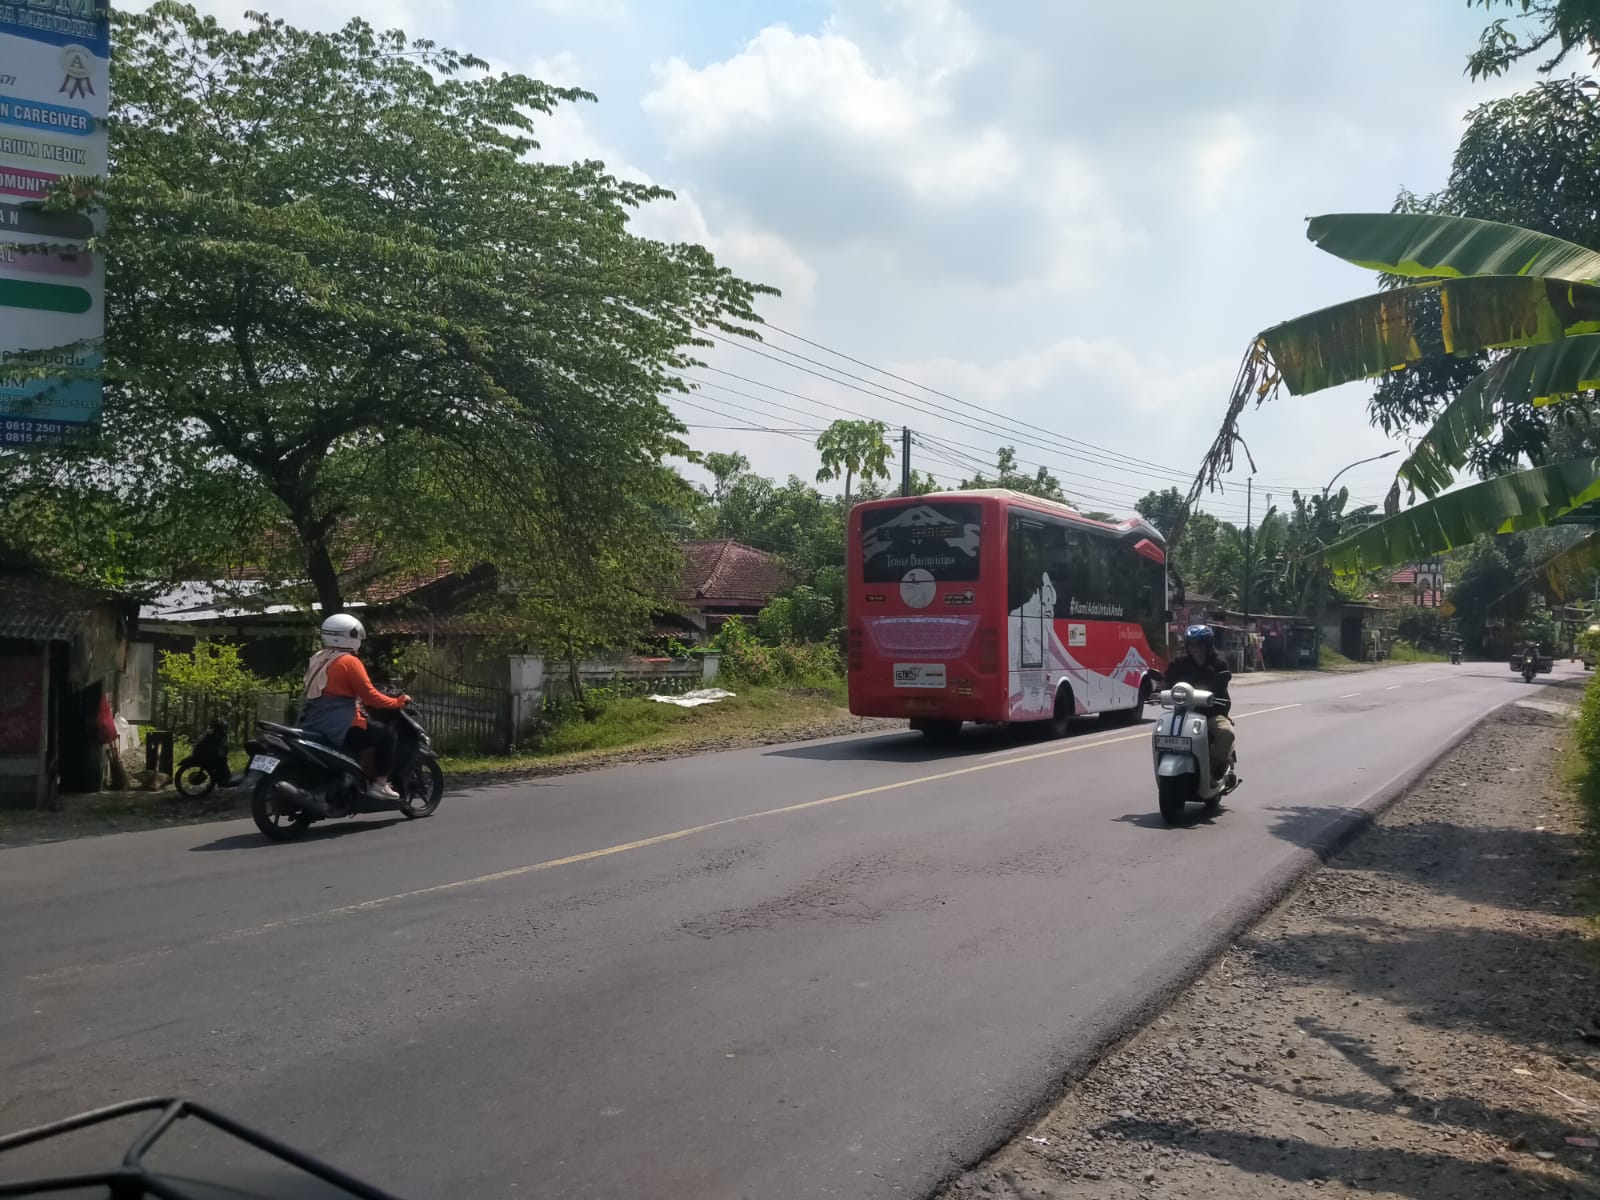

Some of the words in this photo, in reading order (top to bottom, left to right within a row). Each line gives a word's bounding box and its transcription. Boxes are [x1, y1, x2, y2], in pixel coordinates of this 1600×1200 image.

[17, 8, 97, 40] MANDIRI
[68, 55, 86, 70] A
[14, 105, 88, 130] CAREGIVER
[44, 145, 87, 165] MEDIK
[5, 421, 33, 432] 0812
[35, 423, 61, 433] 2501
[5, 432, 33, 442] 0815
